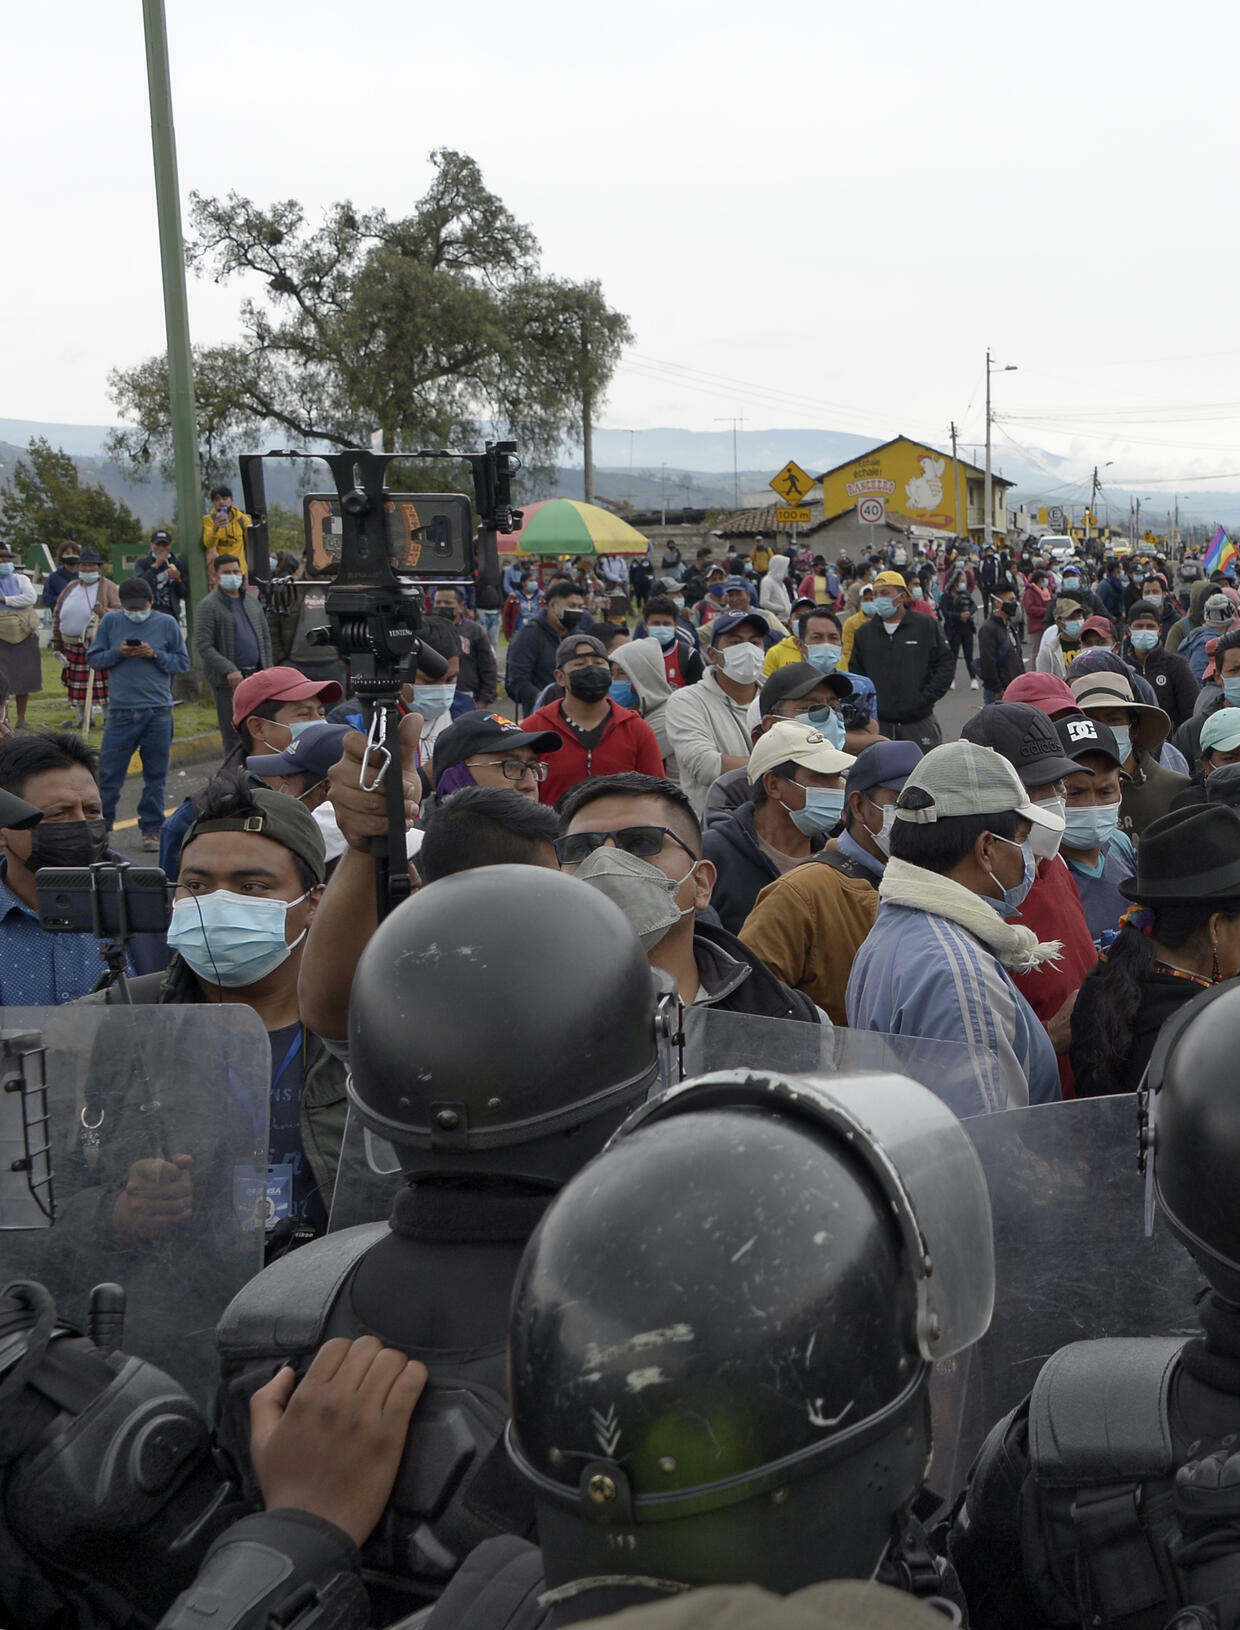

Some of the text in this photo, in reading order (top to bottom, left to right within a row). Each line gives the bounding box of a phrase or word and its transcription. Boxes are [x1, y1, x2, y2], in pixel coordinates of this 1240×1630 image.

[846, 480, 895, 496] RANCHERO
[779, 511, 798, 520] 100
[864, 505, 879, 516] 40
[1021, 740, 1062, 758] adidas
